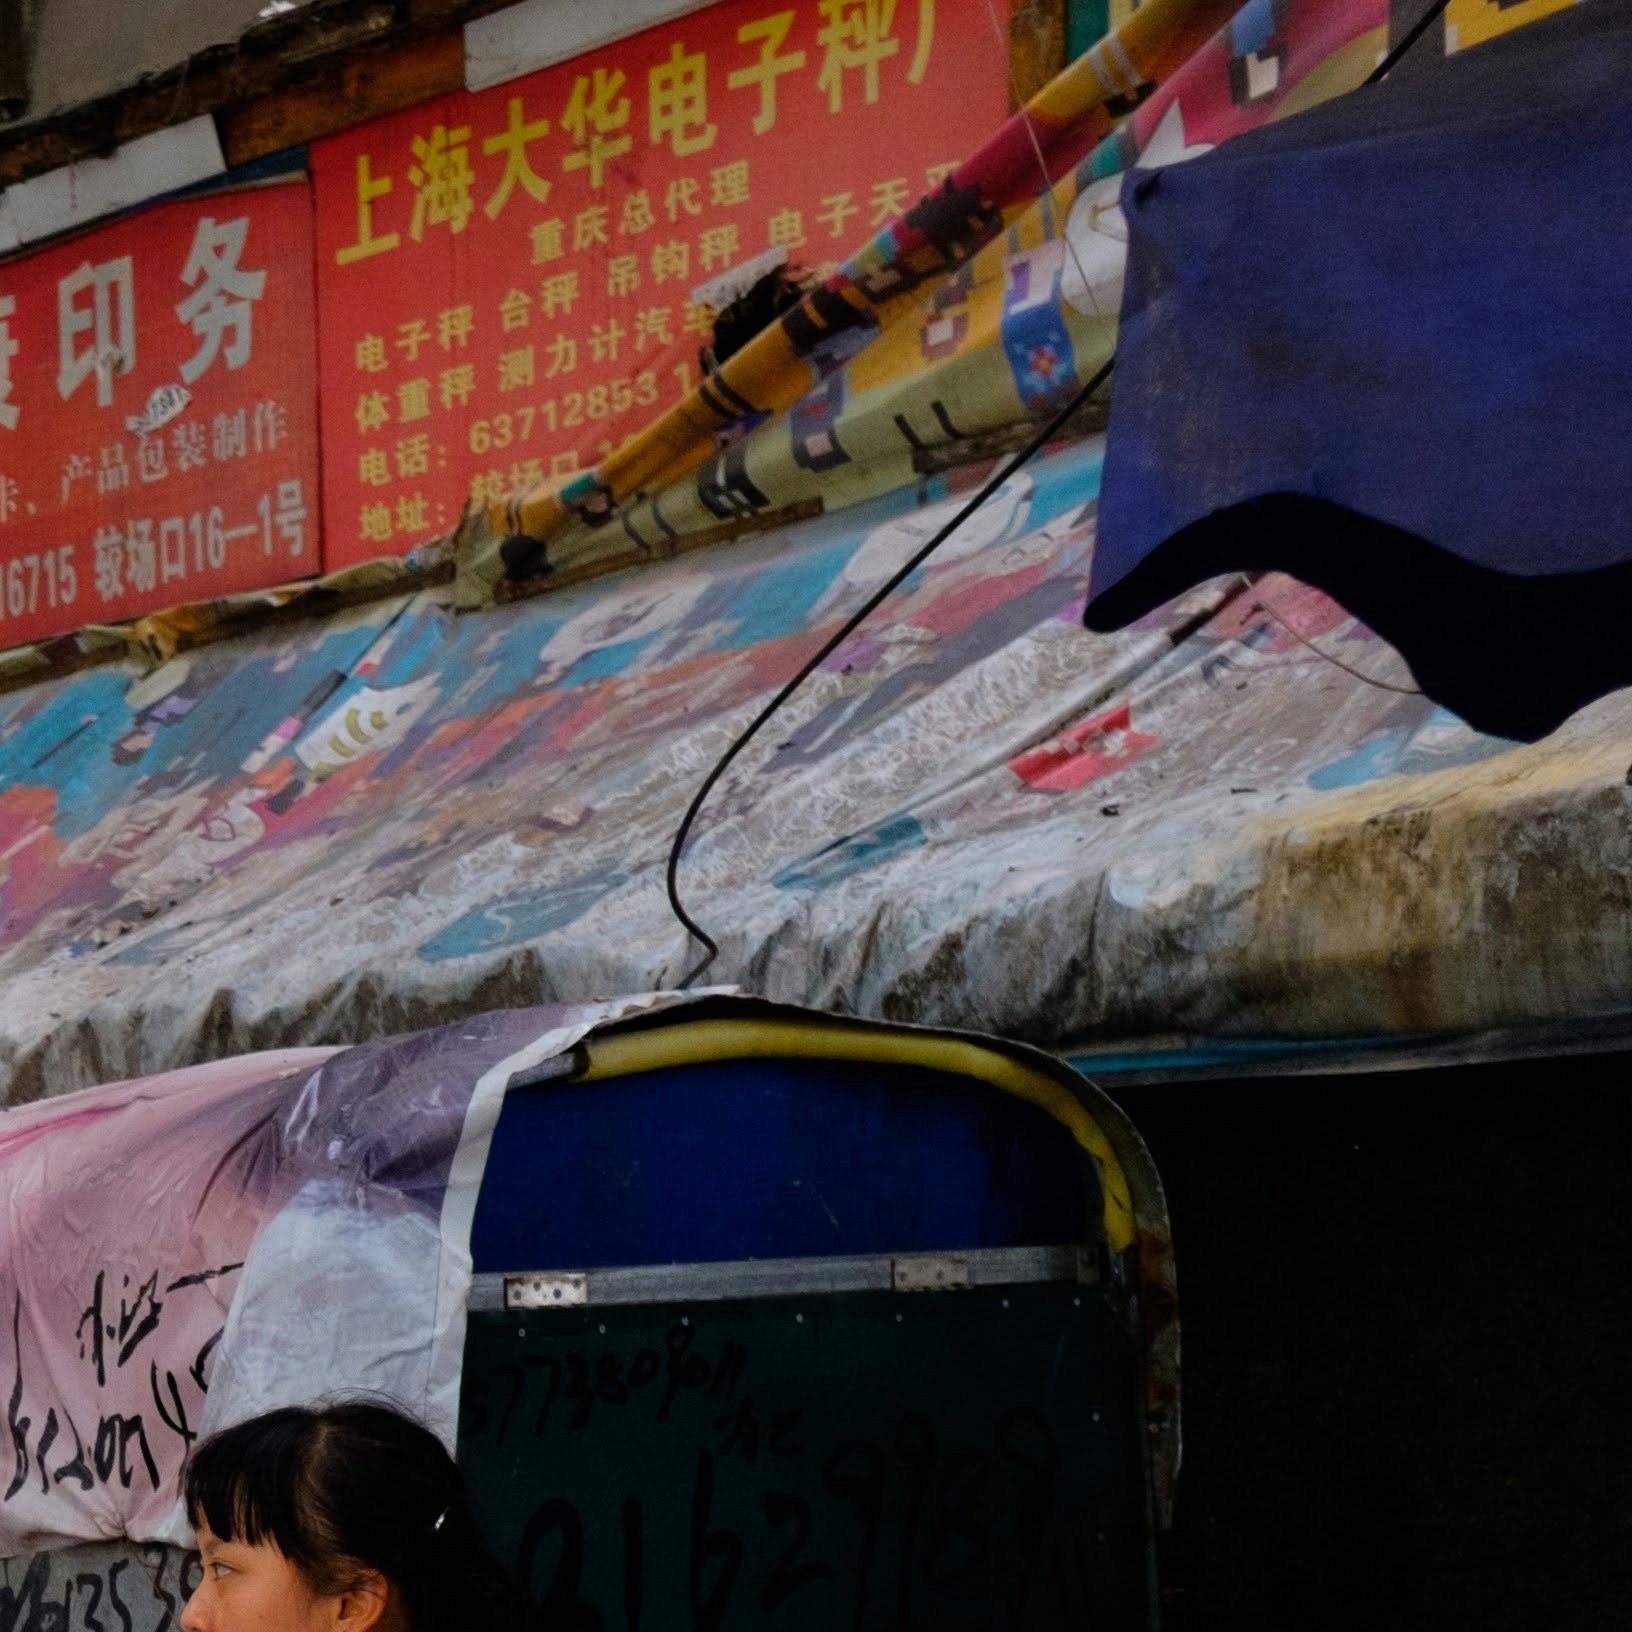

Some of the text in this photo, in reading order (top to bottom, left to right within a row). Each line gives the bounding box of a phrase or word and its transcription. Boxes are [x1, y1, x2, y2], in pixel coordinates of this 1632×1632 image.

[528, 160, 751, 265] 重庆总代理
[354, 306, 475, 373] 电子秤
[499, 271, 580, 334] 台秤
[608, 225, 740, 298] 吊钩秤
[355, 365, 476, 433] 体重秤
[470, 369, 659, 454] 63712853
